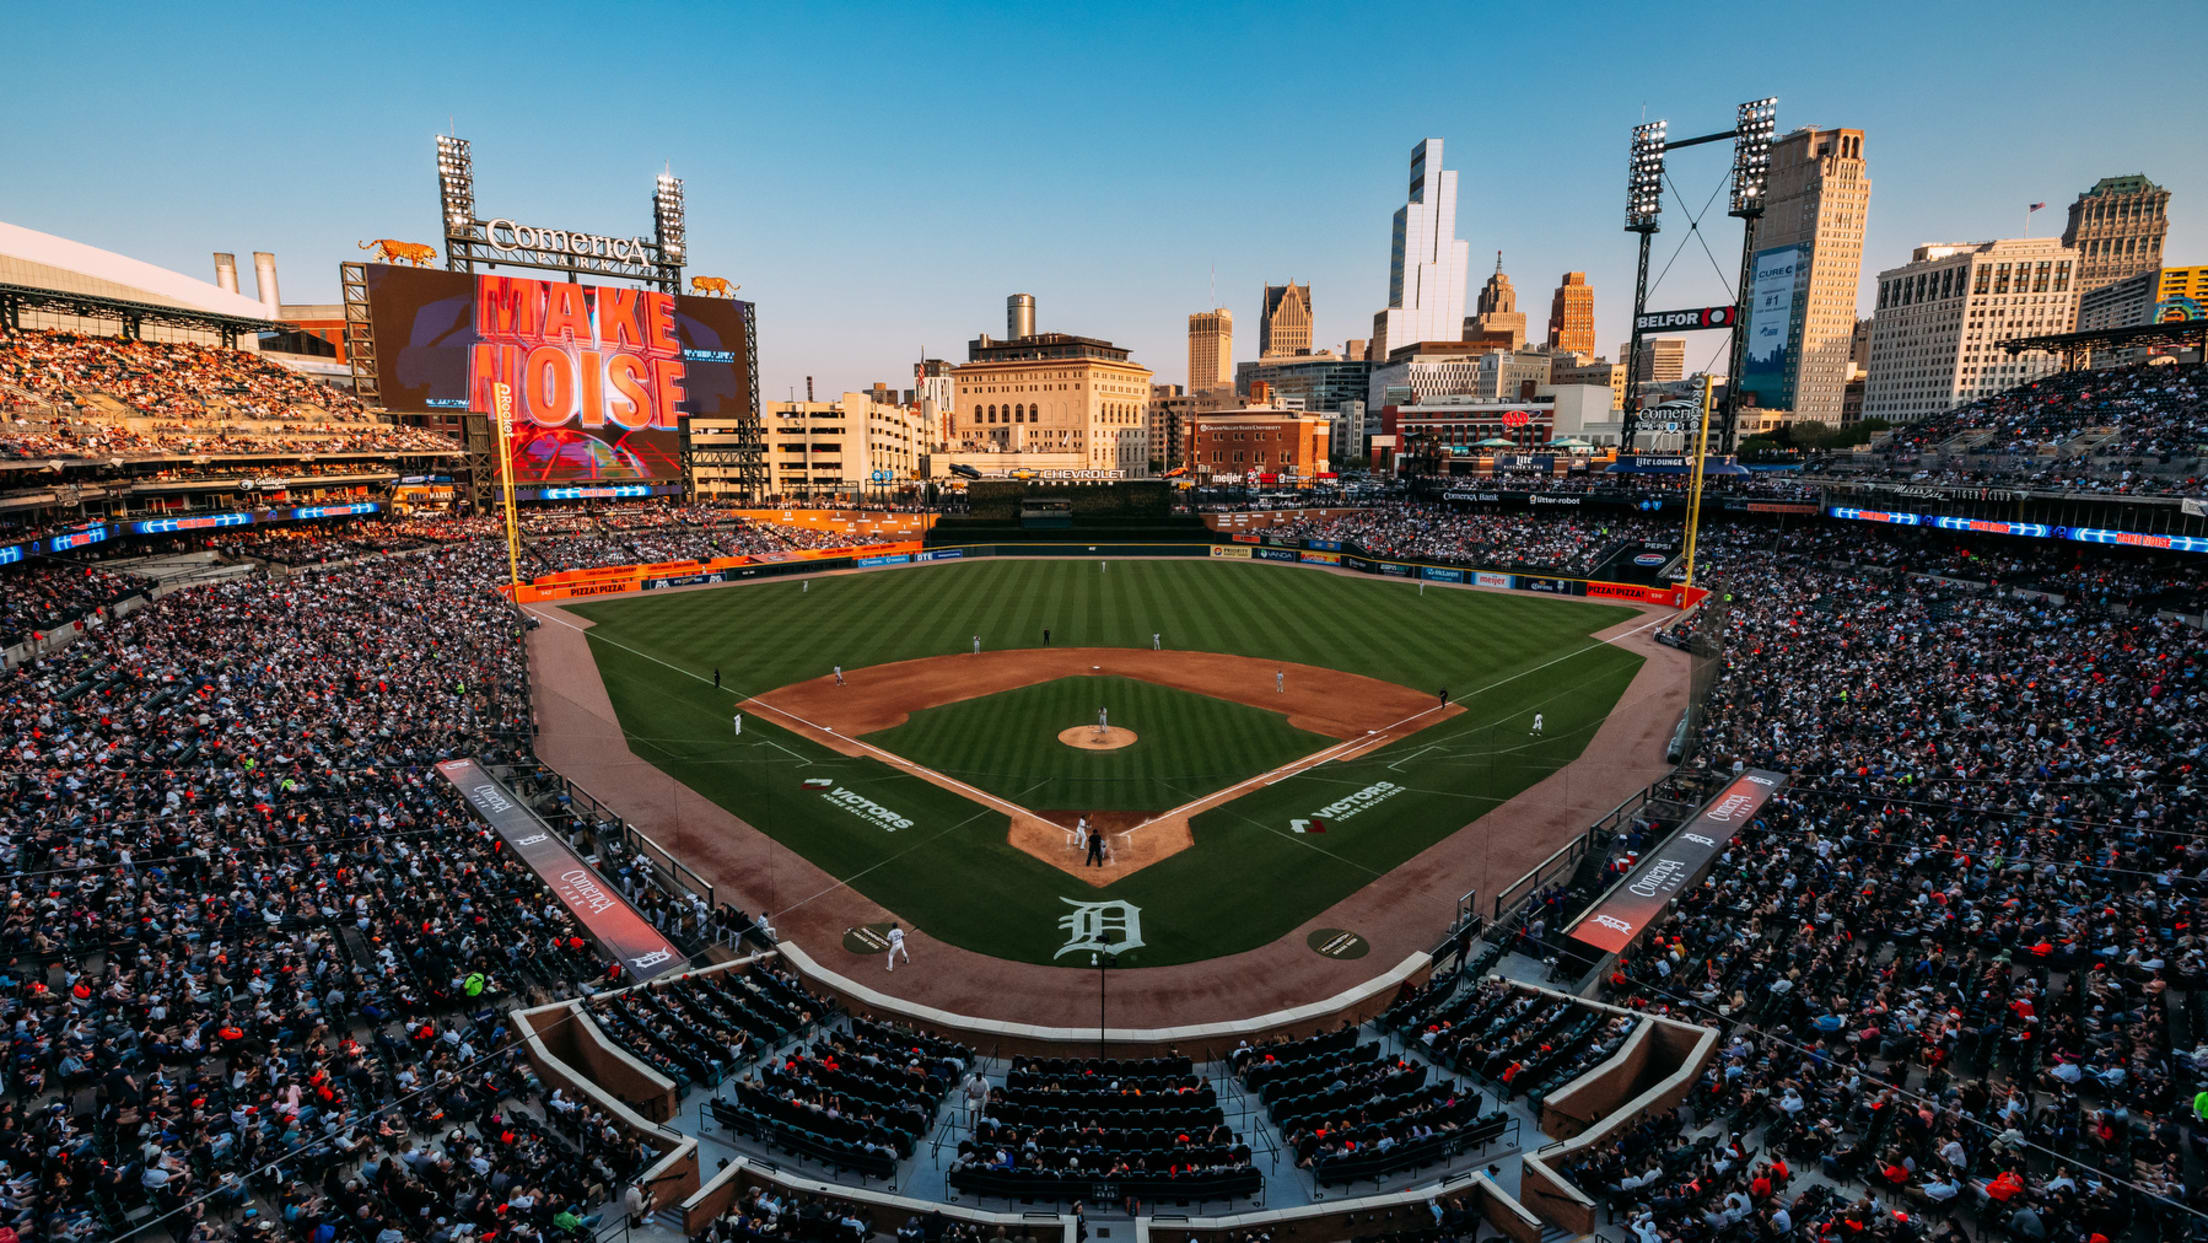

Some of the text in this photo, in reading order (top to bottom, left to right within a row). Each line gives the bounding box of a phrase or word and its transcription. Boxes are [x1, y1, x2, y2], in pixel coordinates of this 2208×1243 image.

[537, 251, 611, 271] PARK
[1759, 267, 1784, 279] CURE
[1765, 294, 1780, 306] #1
[476, 275, 682, 353] MAKE
[1636, 313, 1698, 329] BELFOR
[469, 344, 689, 432] NOISE
[500, 395, 515, 438] Rocket
[1689, 389, 1705, 434] Rocket
[1503, 411, 1529, 427] AAA
[1517, 455, 1533, 466] Lite
[1636, 457, 1652, 467] Lite
[1043, 469, 1127, 479] CHEVROLET
[1212, 472, 1242, 484] meijer
[1480, 493, 1499, 501] Bank
[1537, 496, 1580, 504] litter-robot
[1645, 542, 1671, 550] PEPSI
[2116, 533, 2172, 548] MAKE NOISE
[917, 552, 933, 561] DTE
[1268, 551, 1293, 559] VANDA
[1480, 576, 1505, 585] meijer
[570, 584, 626, 596] PIZZA! PIZZA!
[1588, 586, 1645, 597] PIZZA! PIZZA!
[1310, 781, 1395, 819] VICTORS
[831, 786, 914, 829] VICTORS
[1662, 873, 1686, 892] PARK
[560, 886, 586, 907] PARK
